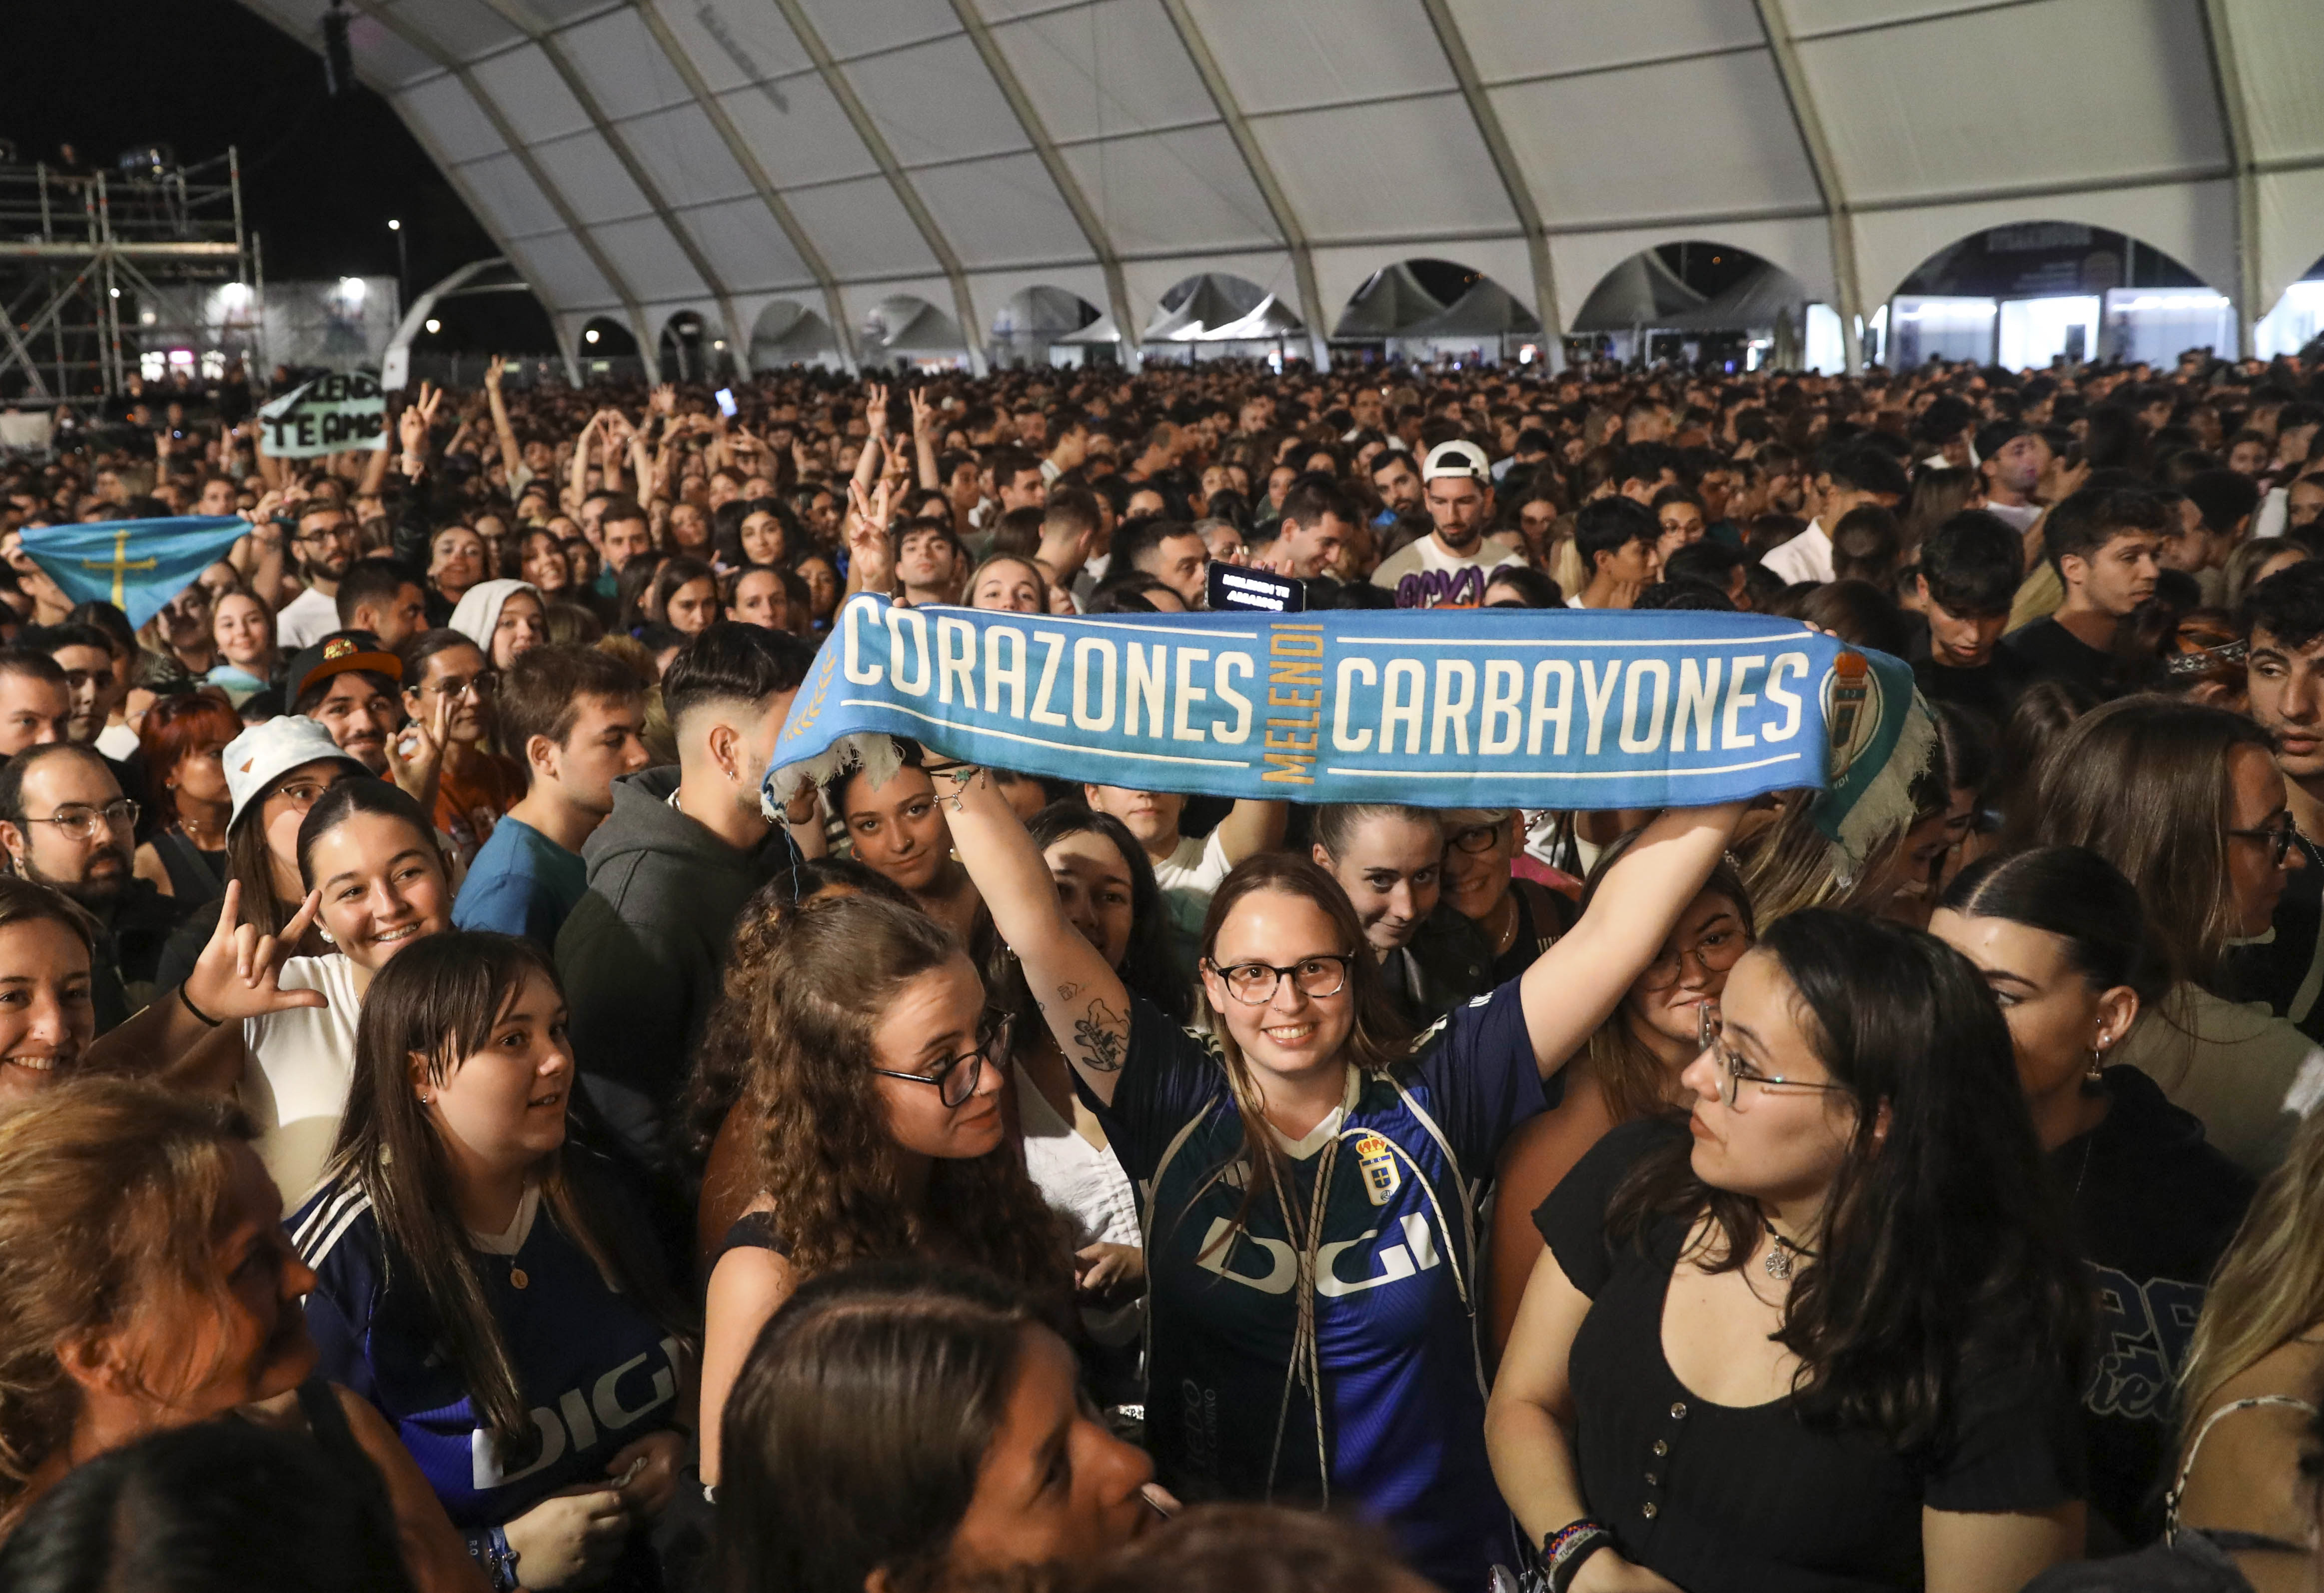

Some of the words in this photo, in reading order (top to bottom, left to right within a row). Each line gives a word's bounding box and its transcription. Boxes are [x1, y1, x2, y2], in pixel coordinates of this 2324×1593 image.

[262, 414, 316, 446] TE
[843, 595, 1255, 744] CORAZONES
[1261, 624, 1324, 784] MELENDI
[1332, 652, 1810, 756] CARBAYONES
